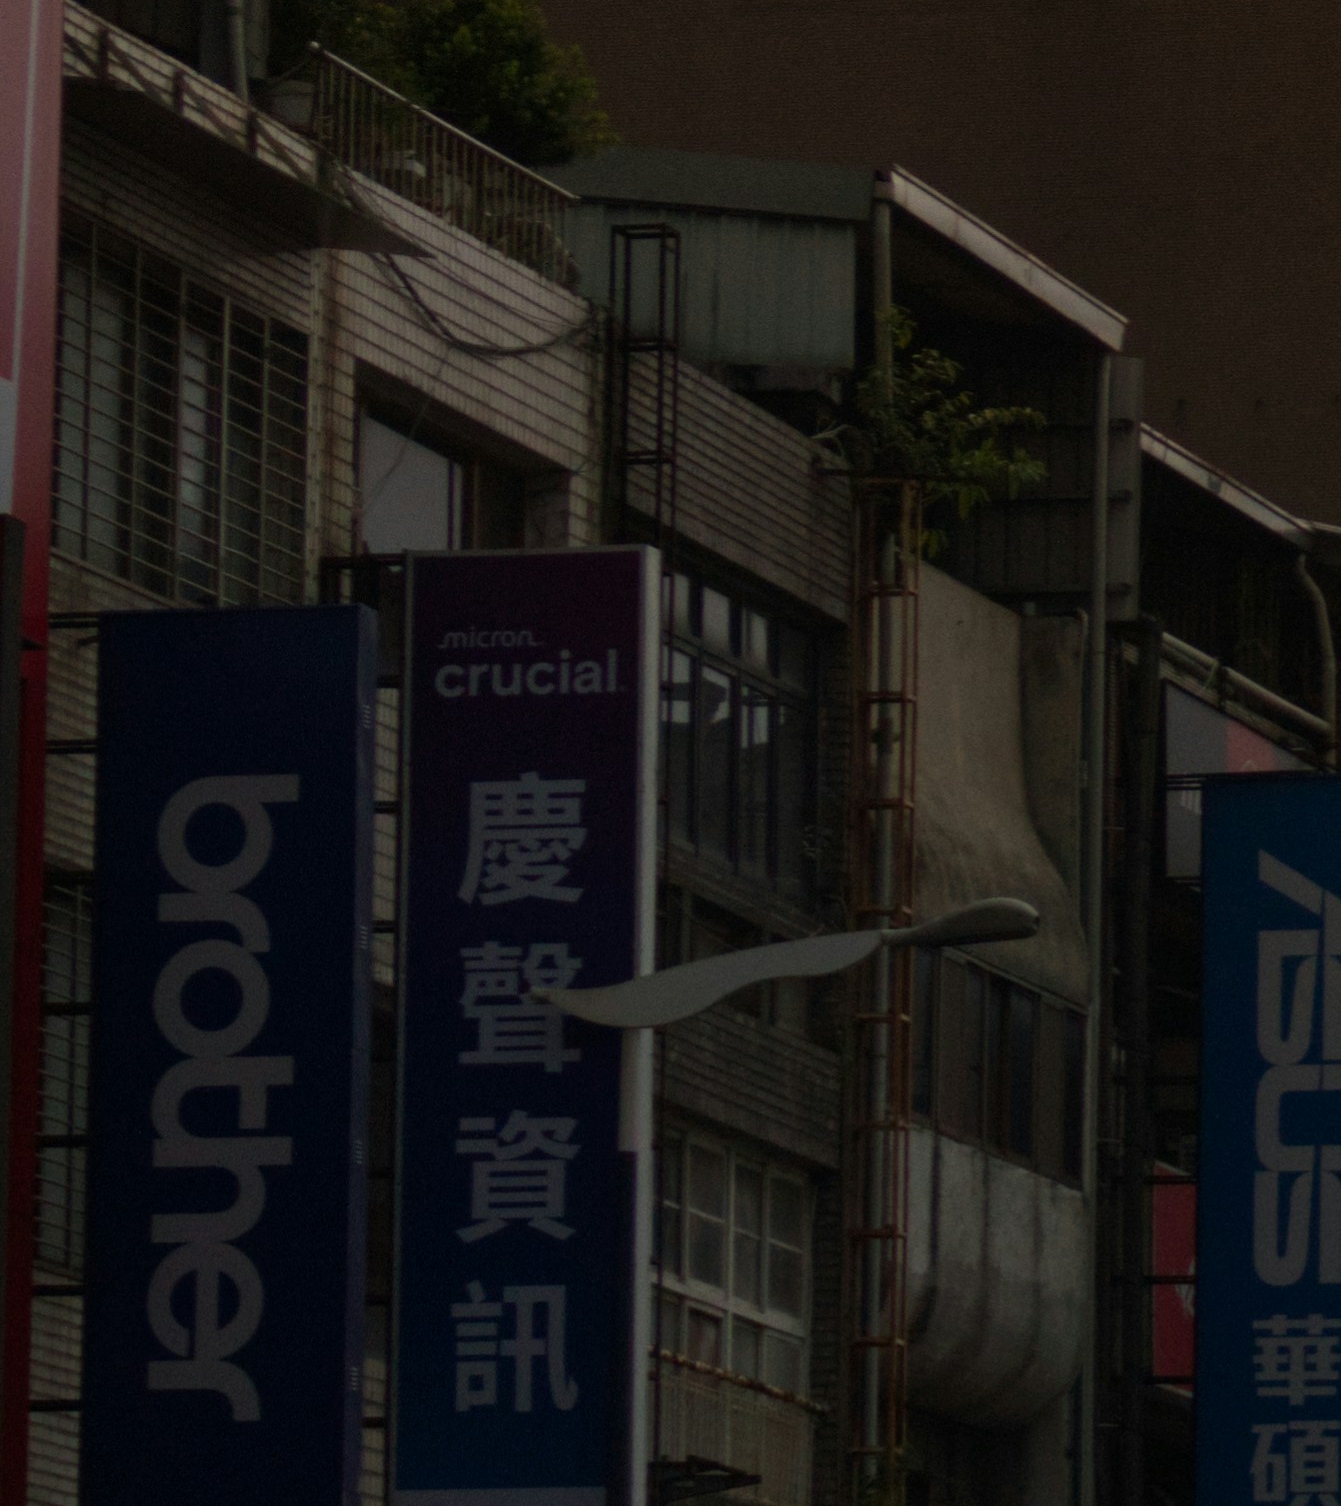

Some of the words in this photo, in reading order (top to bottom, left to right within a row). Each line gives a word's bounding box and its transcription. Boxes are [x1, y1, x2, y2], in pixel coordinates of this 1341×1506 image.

[434, 648, 617, 698] crucial
[436, 625, 543, 649] micron
[146, 773, 301, 1421] brother
[451, 772, 588, 1415] 慶聲資訊
